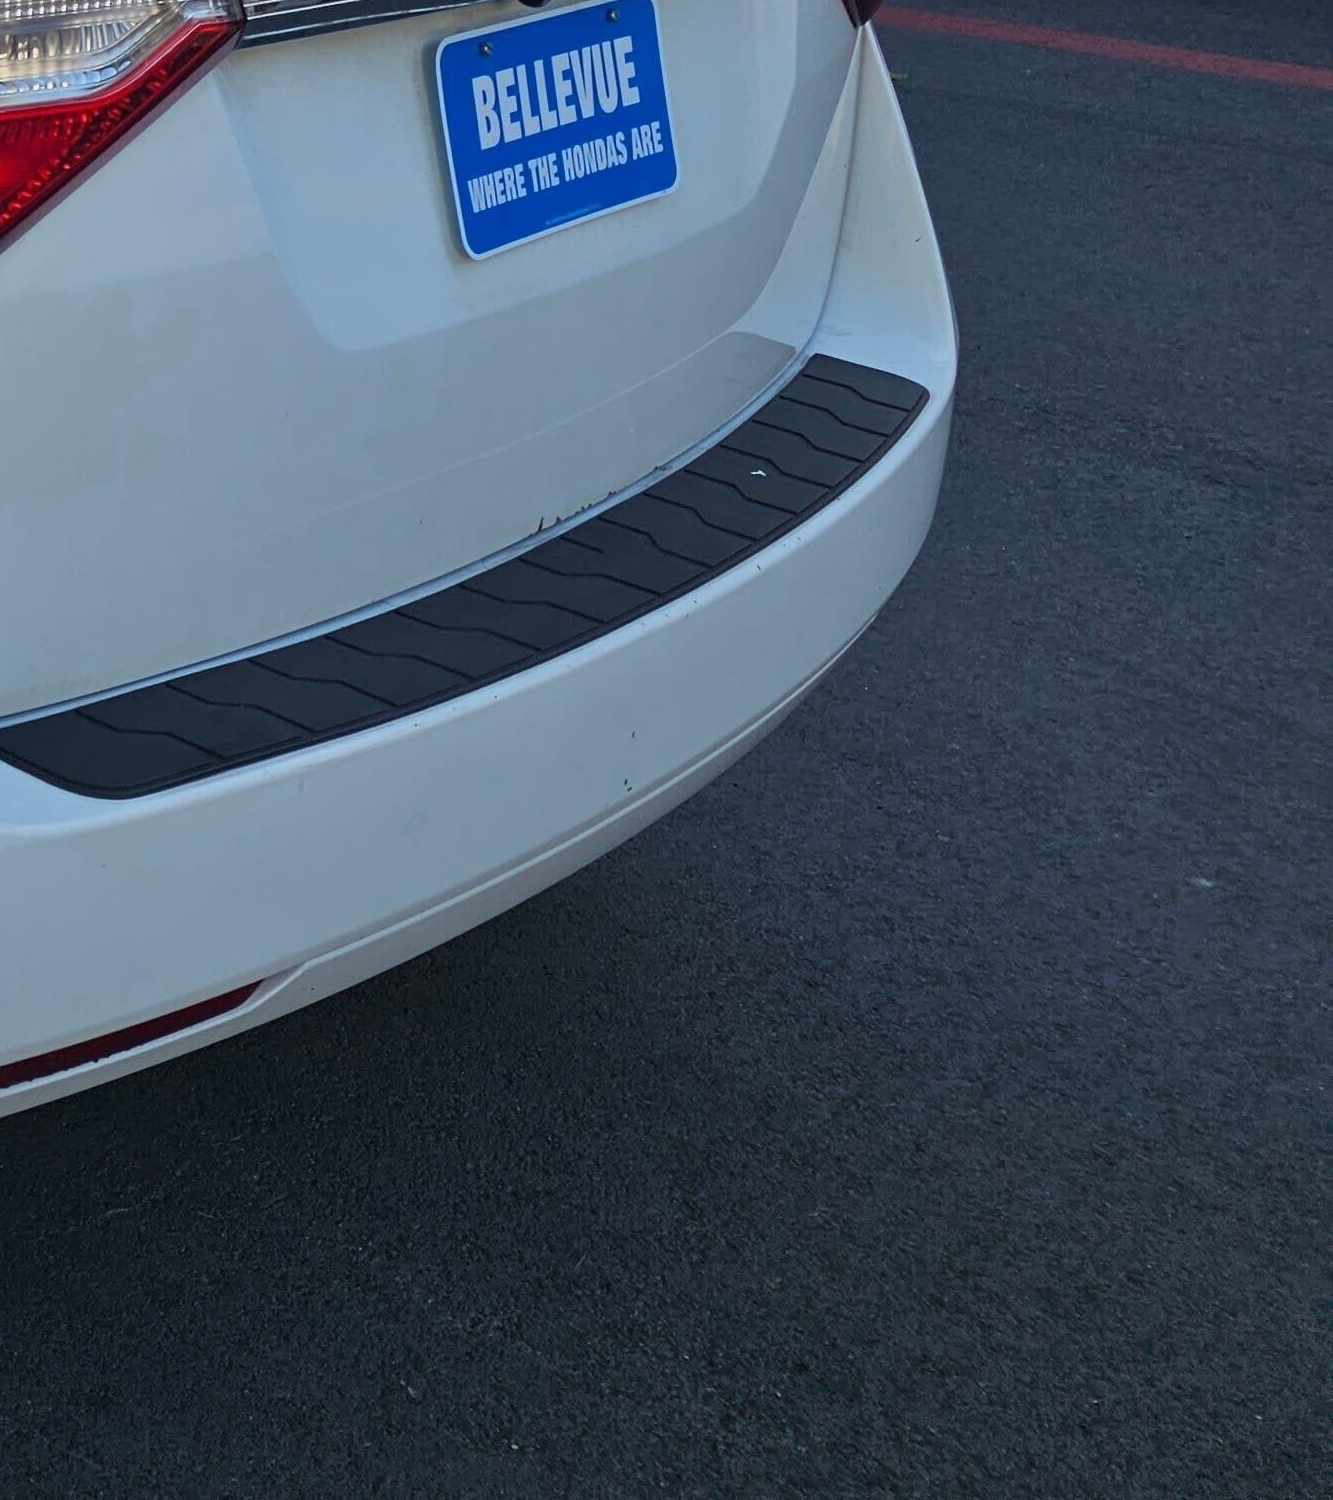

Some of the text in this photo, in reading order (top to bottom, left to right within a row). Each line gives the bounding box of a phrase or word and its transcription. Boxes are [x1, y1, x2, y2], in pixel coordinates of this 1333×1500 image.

[471, 35, 641, 151] BELLEVUE
[468, 121, 663, 212] WHERE THE HONDAS ARE
